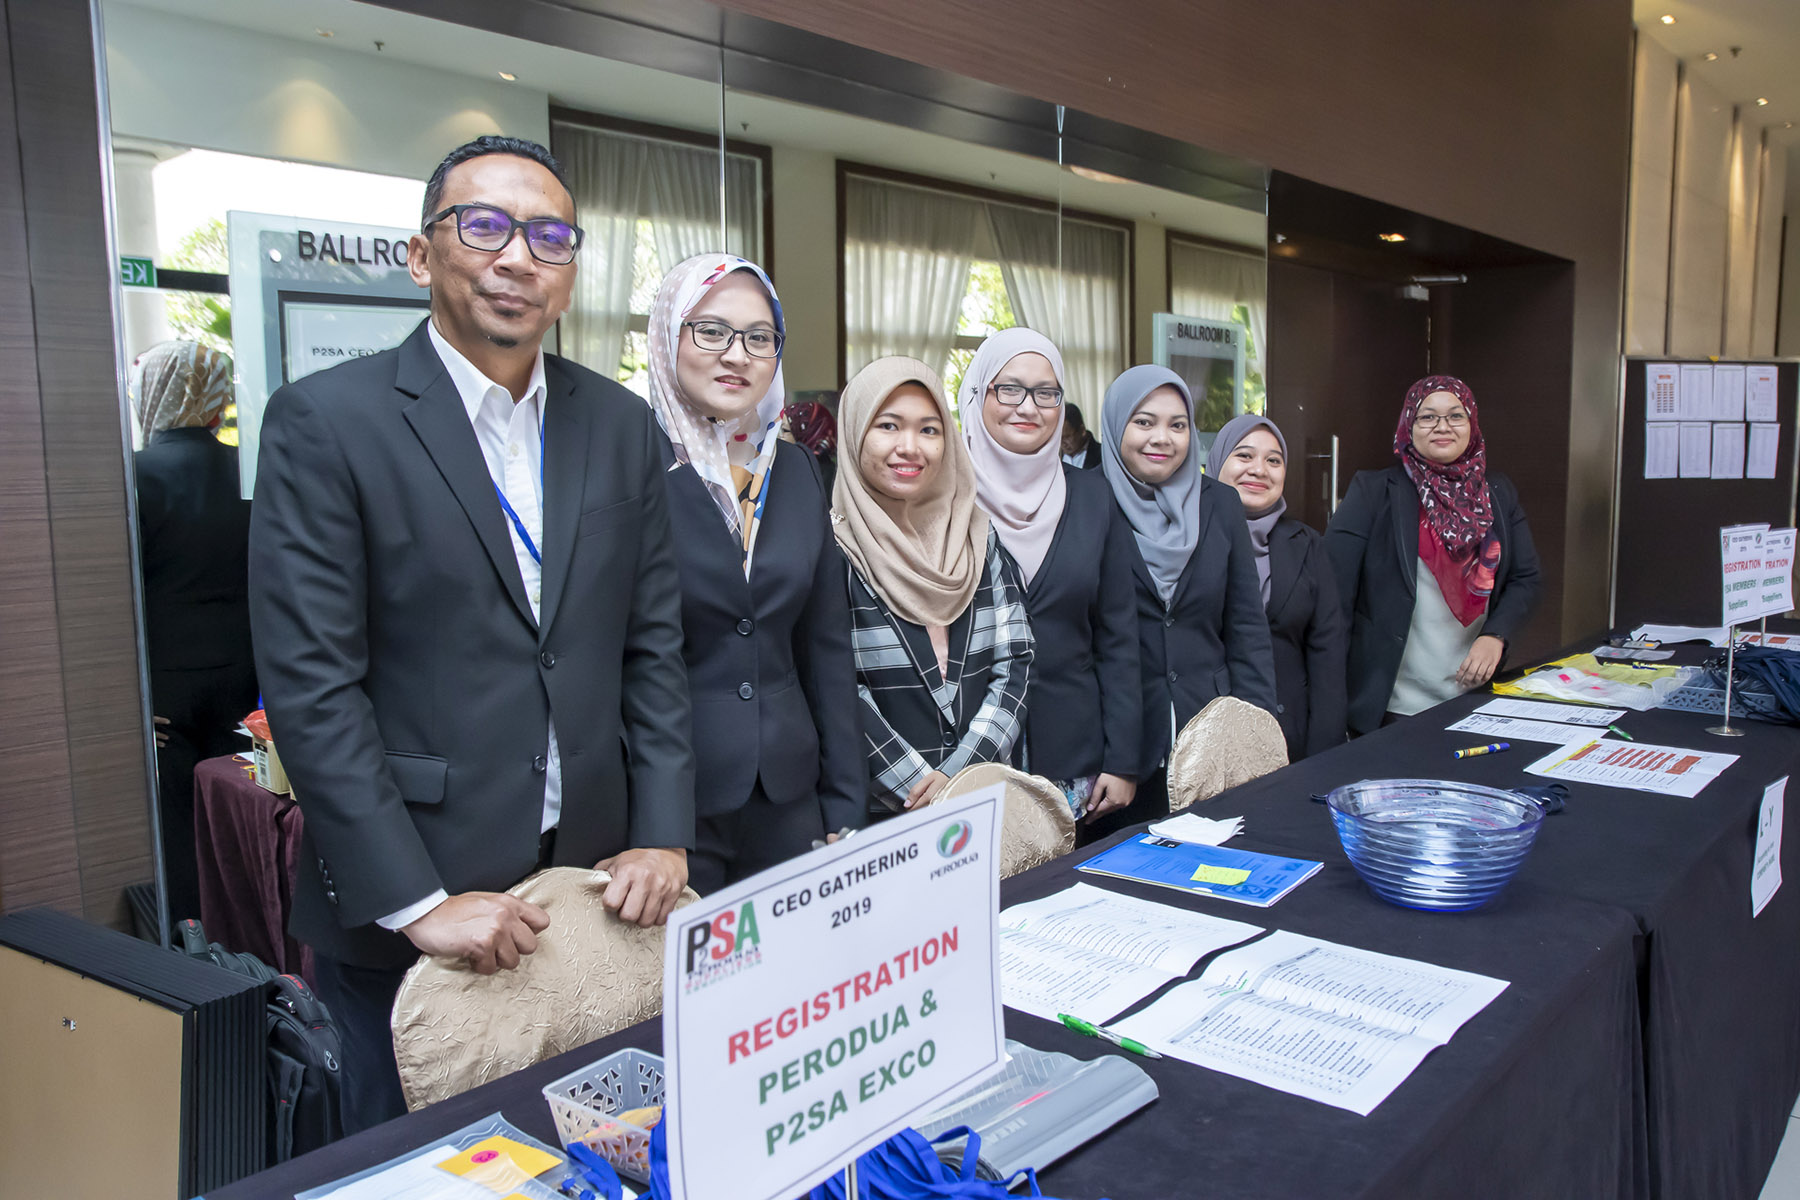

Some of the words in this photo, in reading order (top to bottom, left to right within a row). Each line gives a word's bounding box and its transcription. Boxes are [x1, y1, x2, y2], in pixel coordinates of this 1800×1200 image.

[312, 347, 345, 357] P2SA
[1177, 323, 1223, 343] BALLROOM
[1225, 329, 1231, 344] B
[772, 888, 812, 917] CEO
[818, 842, 918, 898] GATHERING
[831, 896, 872, 929] 2019
[728, 926, 959, 1065] REGISTRATION
[759, 1003, 910, 1105] PERODUA
[919, 988, 938, 1018] &
[766, 1089, 848, 1157] P2SA
[858, 1039, 936, 1103] EXCO
